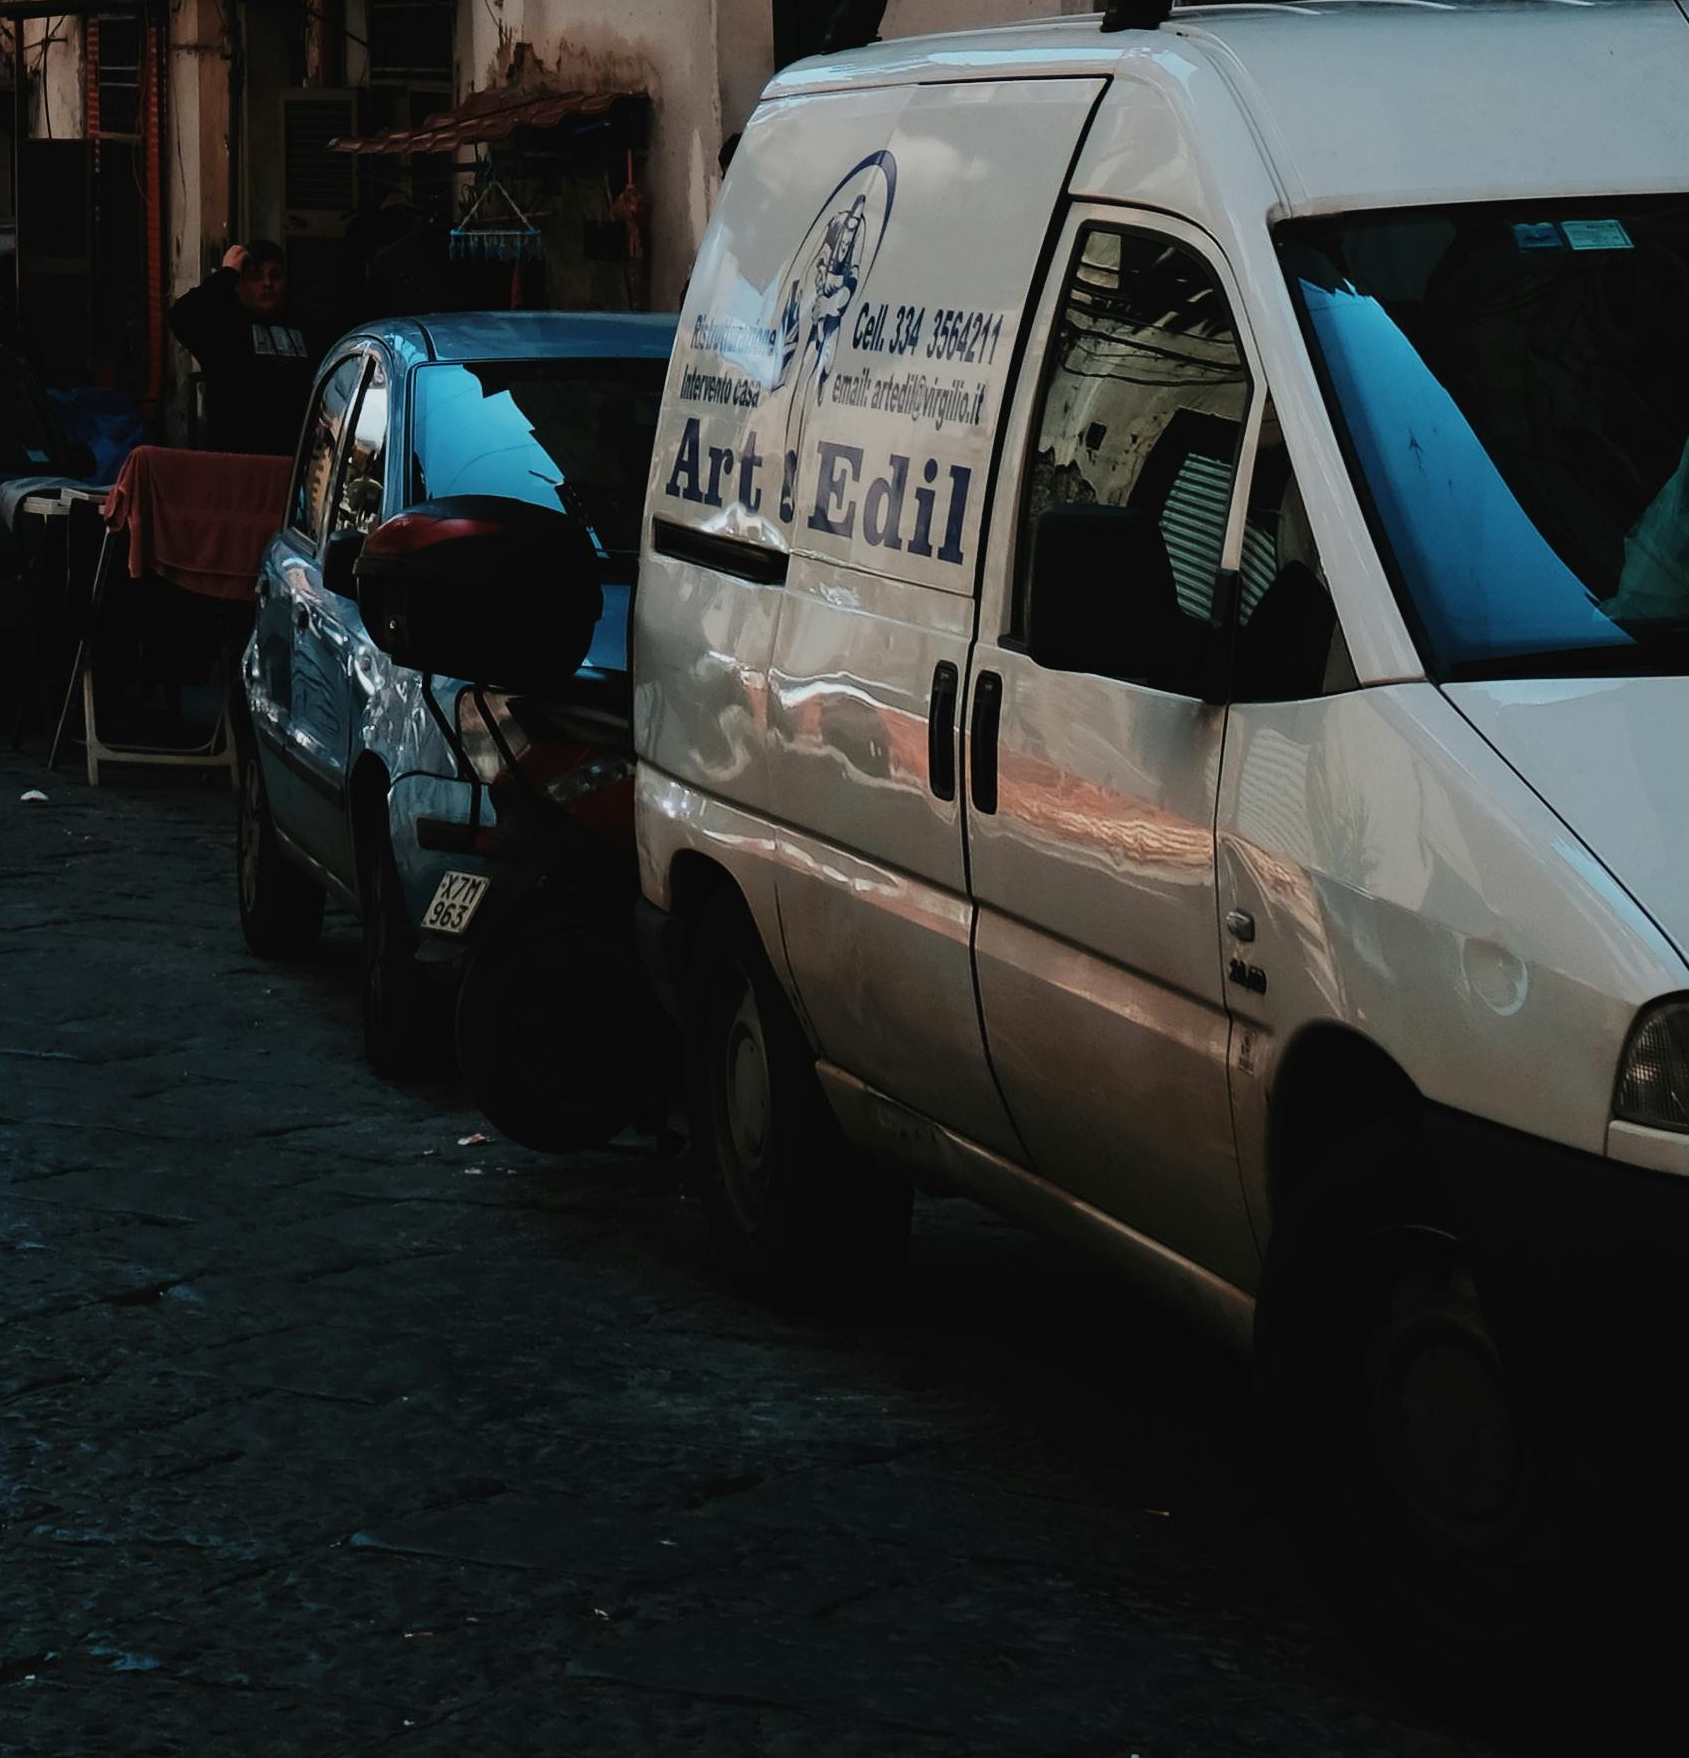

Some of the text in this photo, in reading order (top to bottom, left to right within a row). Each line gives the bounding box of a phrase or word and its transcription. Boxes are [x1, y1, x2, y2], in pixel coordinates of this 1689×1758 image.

[852, 301, 1005, 365] Cell. 334 3564211
[679, 363, 762, 409] Intervento casa
[831, 366, 987, 432] email: artedil@virgilio.it
[665, 417, 973, 566] Art Edil
[429, 901, 469, 929] 963
[440, 874, 482, 904] X7M
